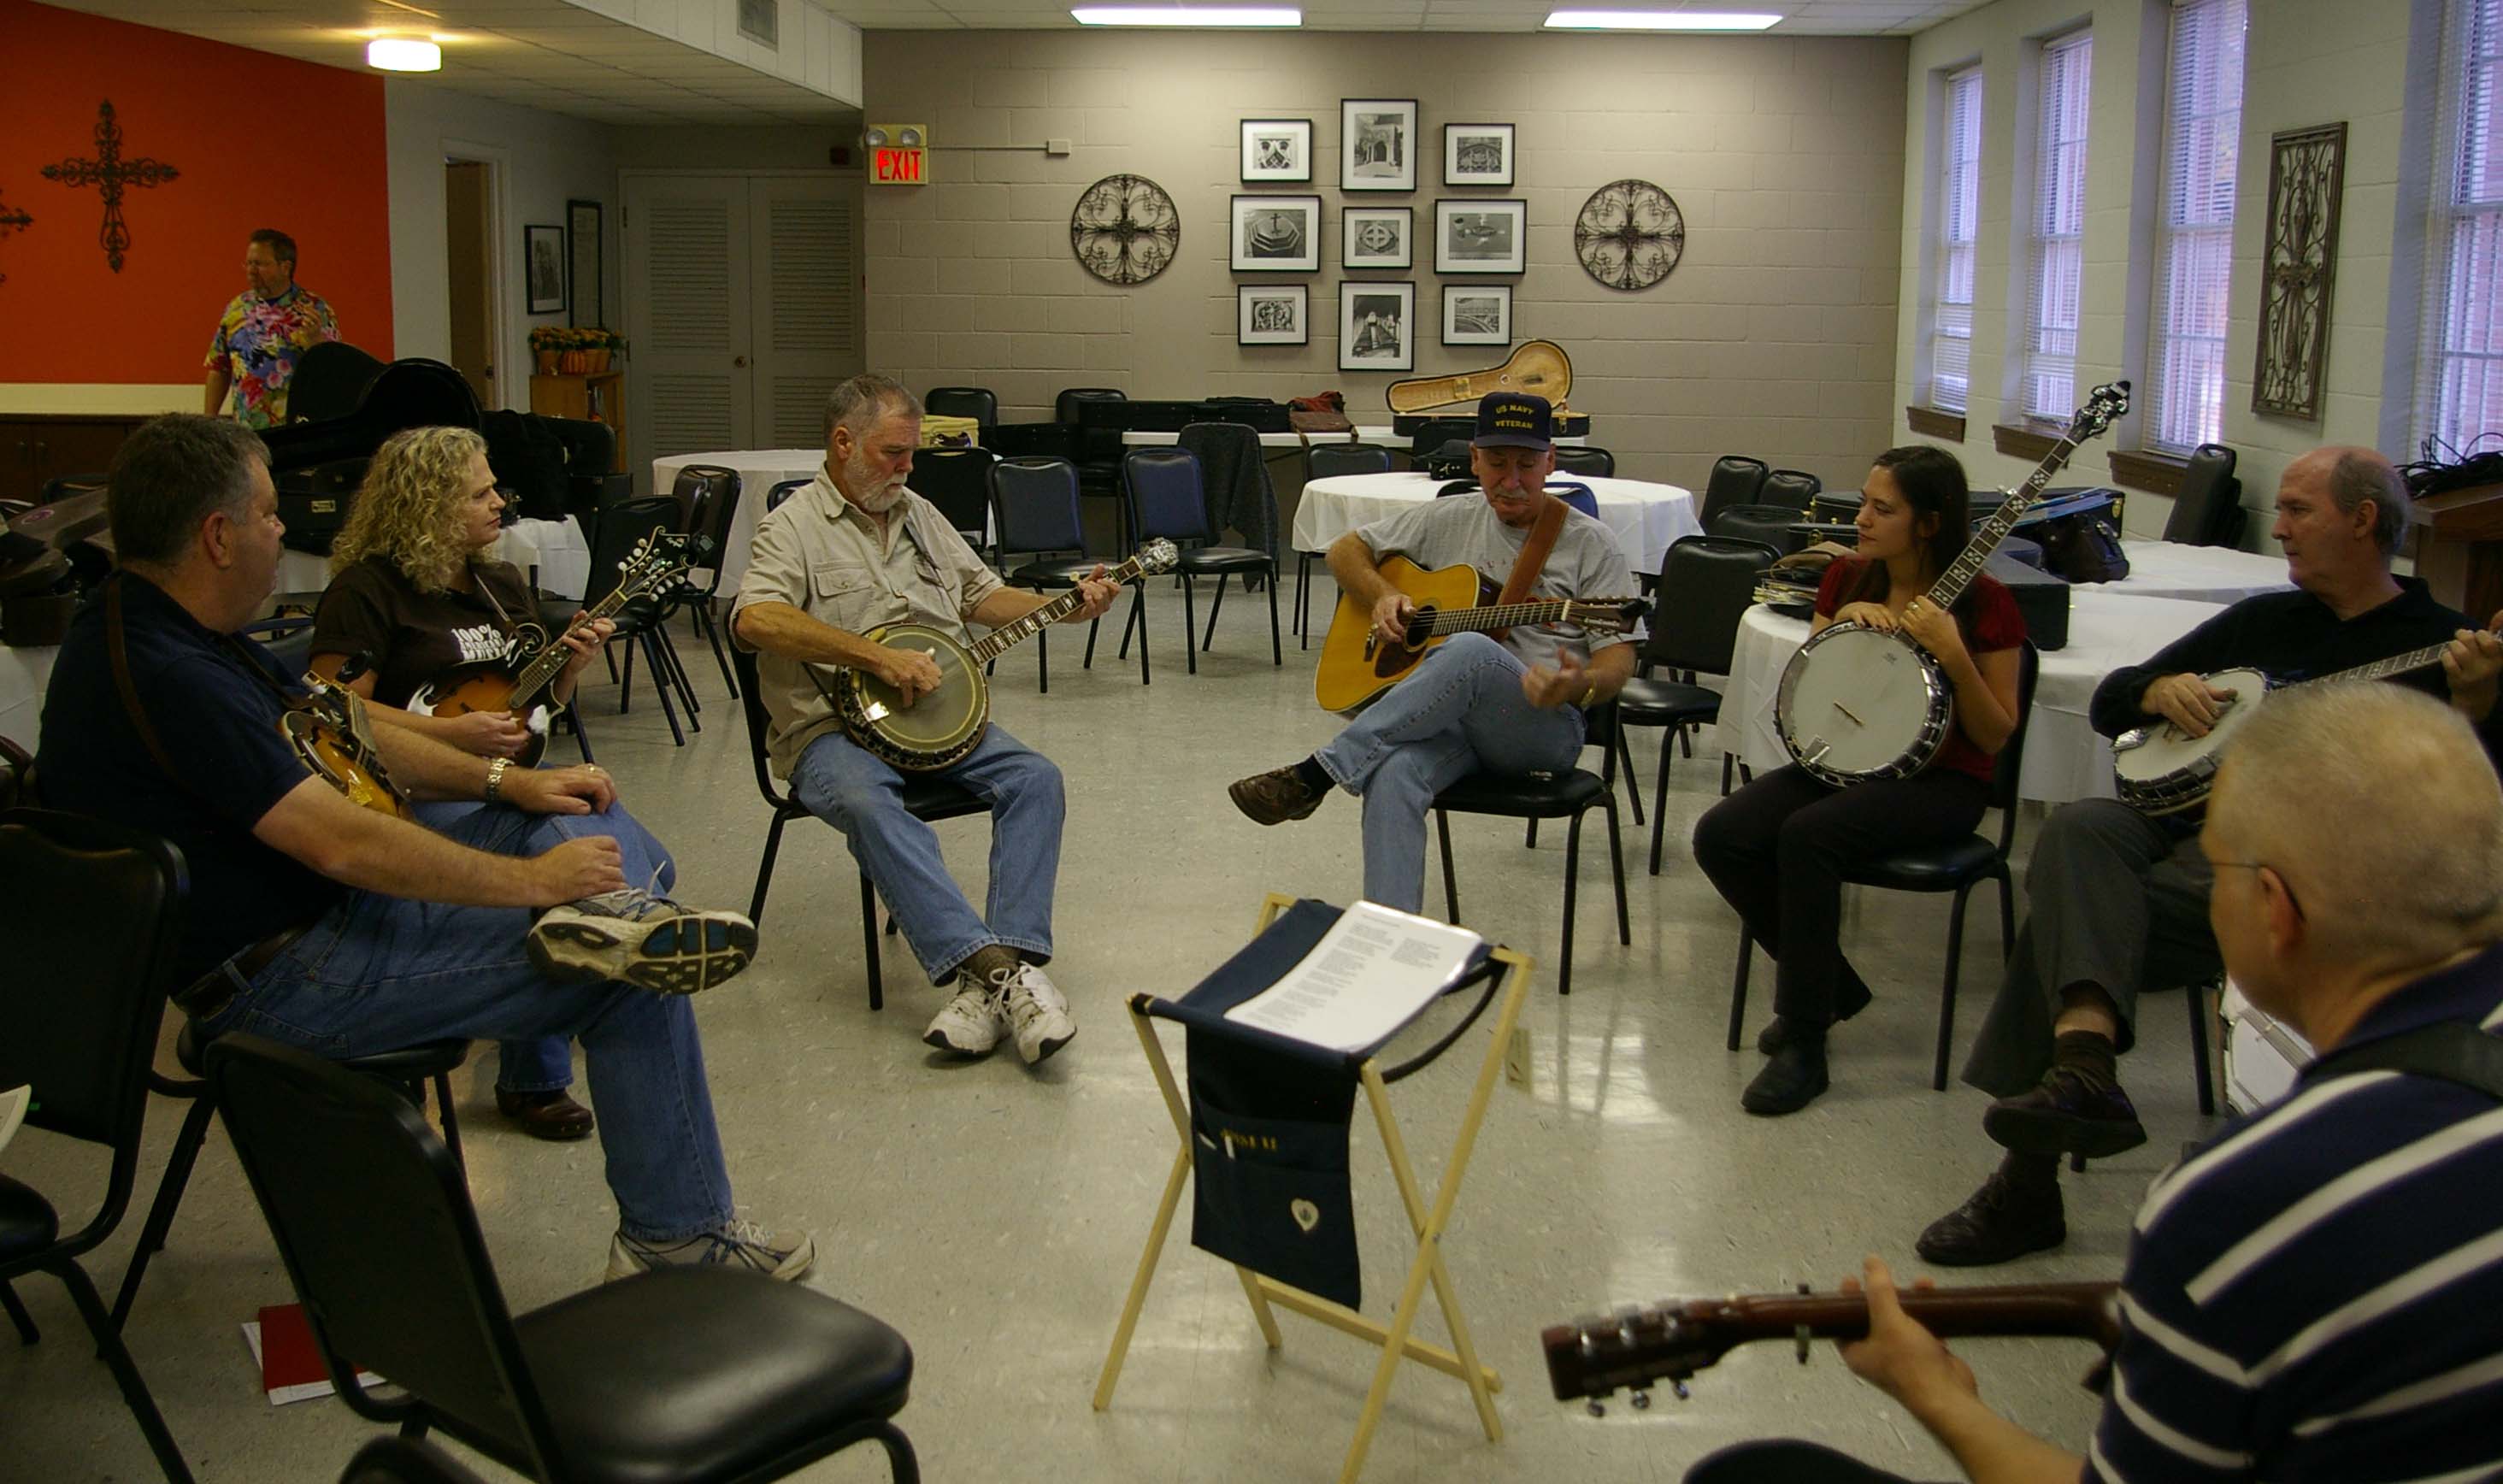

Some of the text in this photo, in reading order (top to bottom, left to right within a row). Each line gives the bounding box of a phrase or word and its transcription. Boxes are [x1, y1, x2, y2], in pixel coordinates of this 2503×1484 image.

[876, 150, 922, 181] EXIT
[1495, 403, 1534, 415] US NAVY
[1494, 420, 1533, 429] VETERAN
[451, 623, 501, 643] 100%
